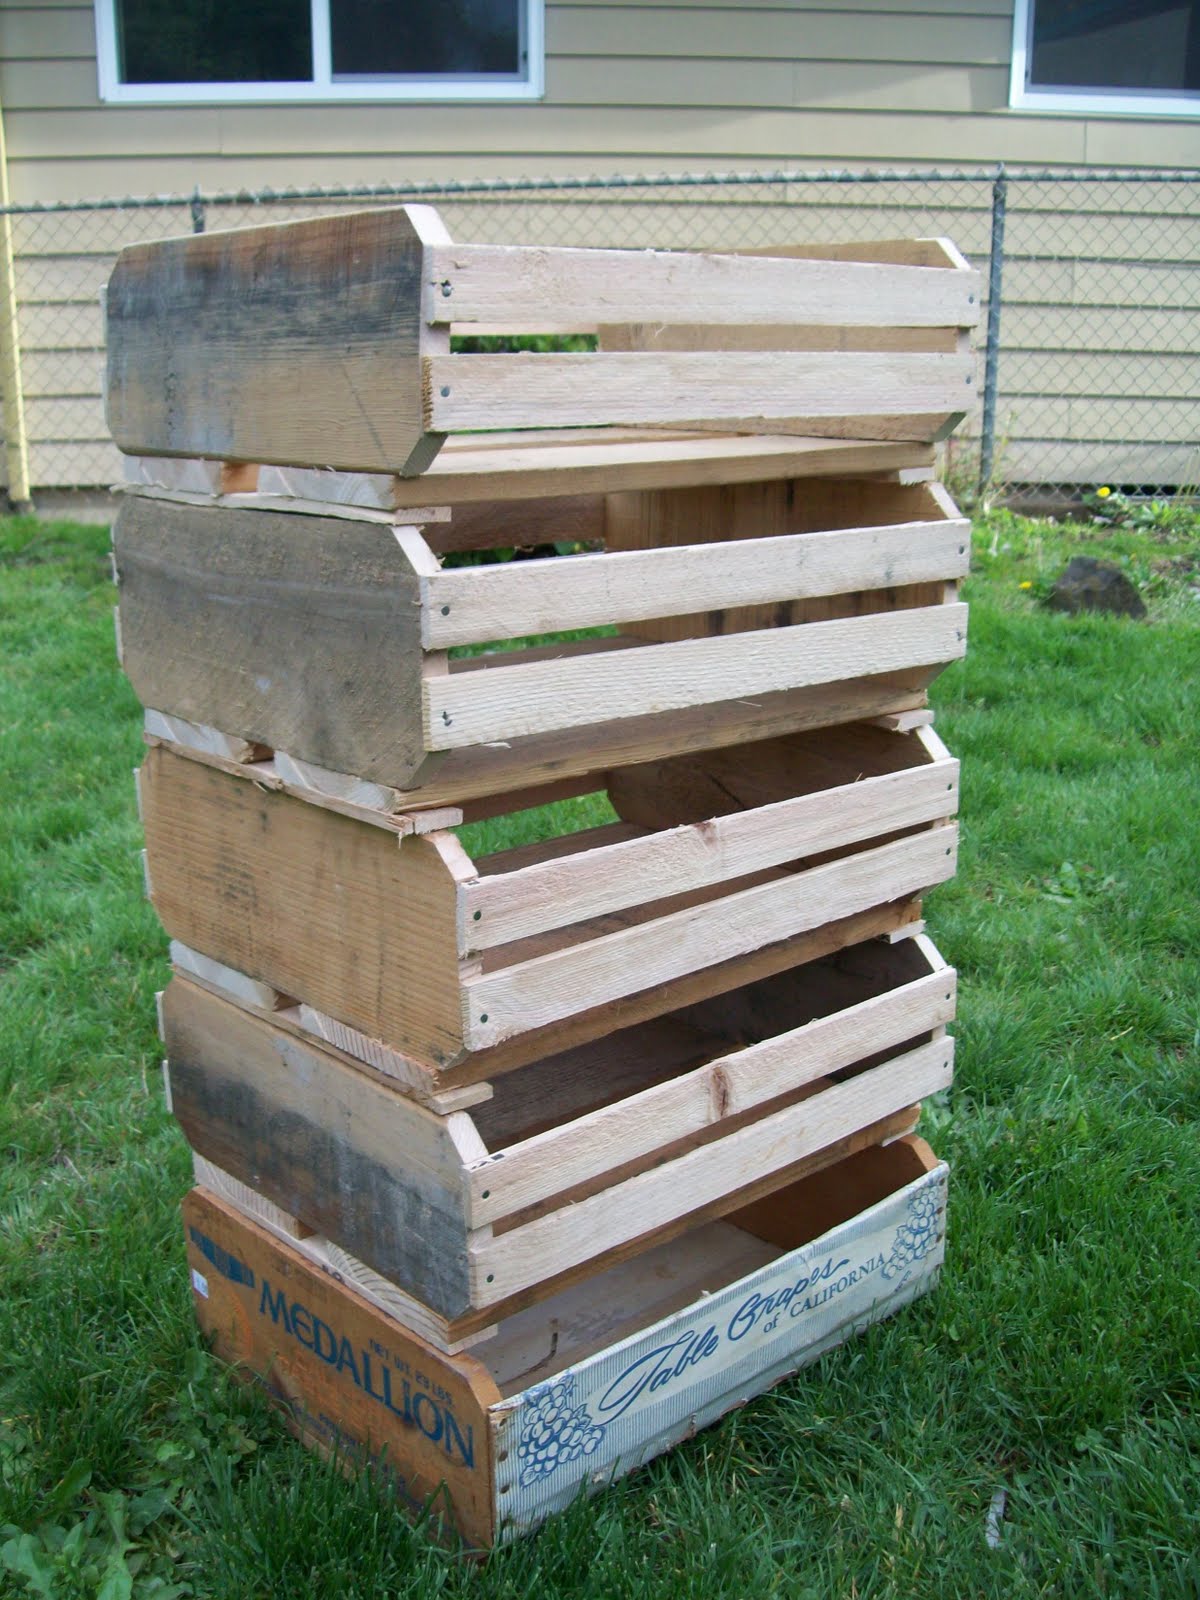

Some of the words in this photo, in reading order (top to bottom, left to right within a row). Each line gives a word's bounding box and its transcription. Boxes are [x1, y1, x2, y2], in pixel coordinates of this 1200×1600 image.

[259, 1278, 476, 1470] MEDALLION
[594, 1324, 720, 1427] Table
[727, 1257, 850, 1342] Grapes
[762, 1312, 782, 1334] of
[789, 1252, 886, 1318] CALIFORNIA
